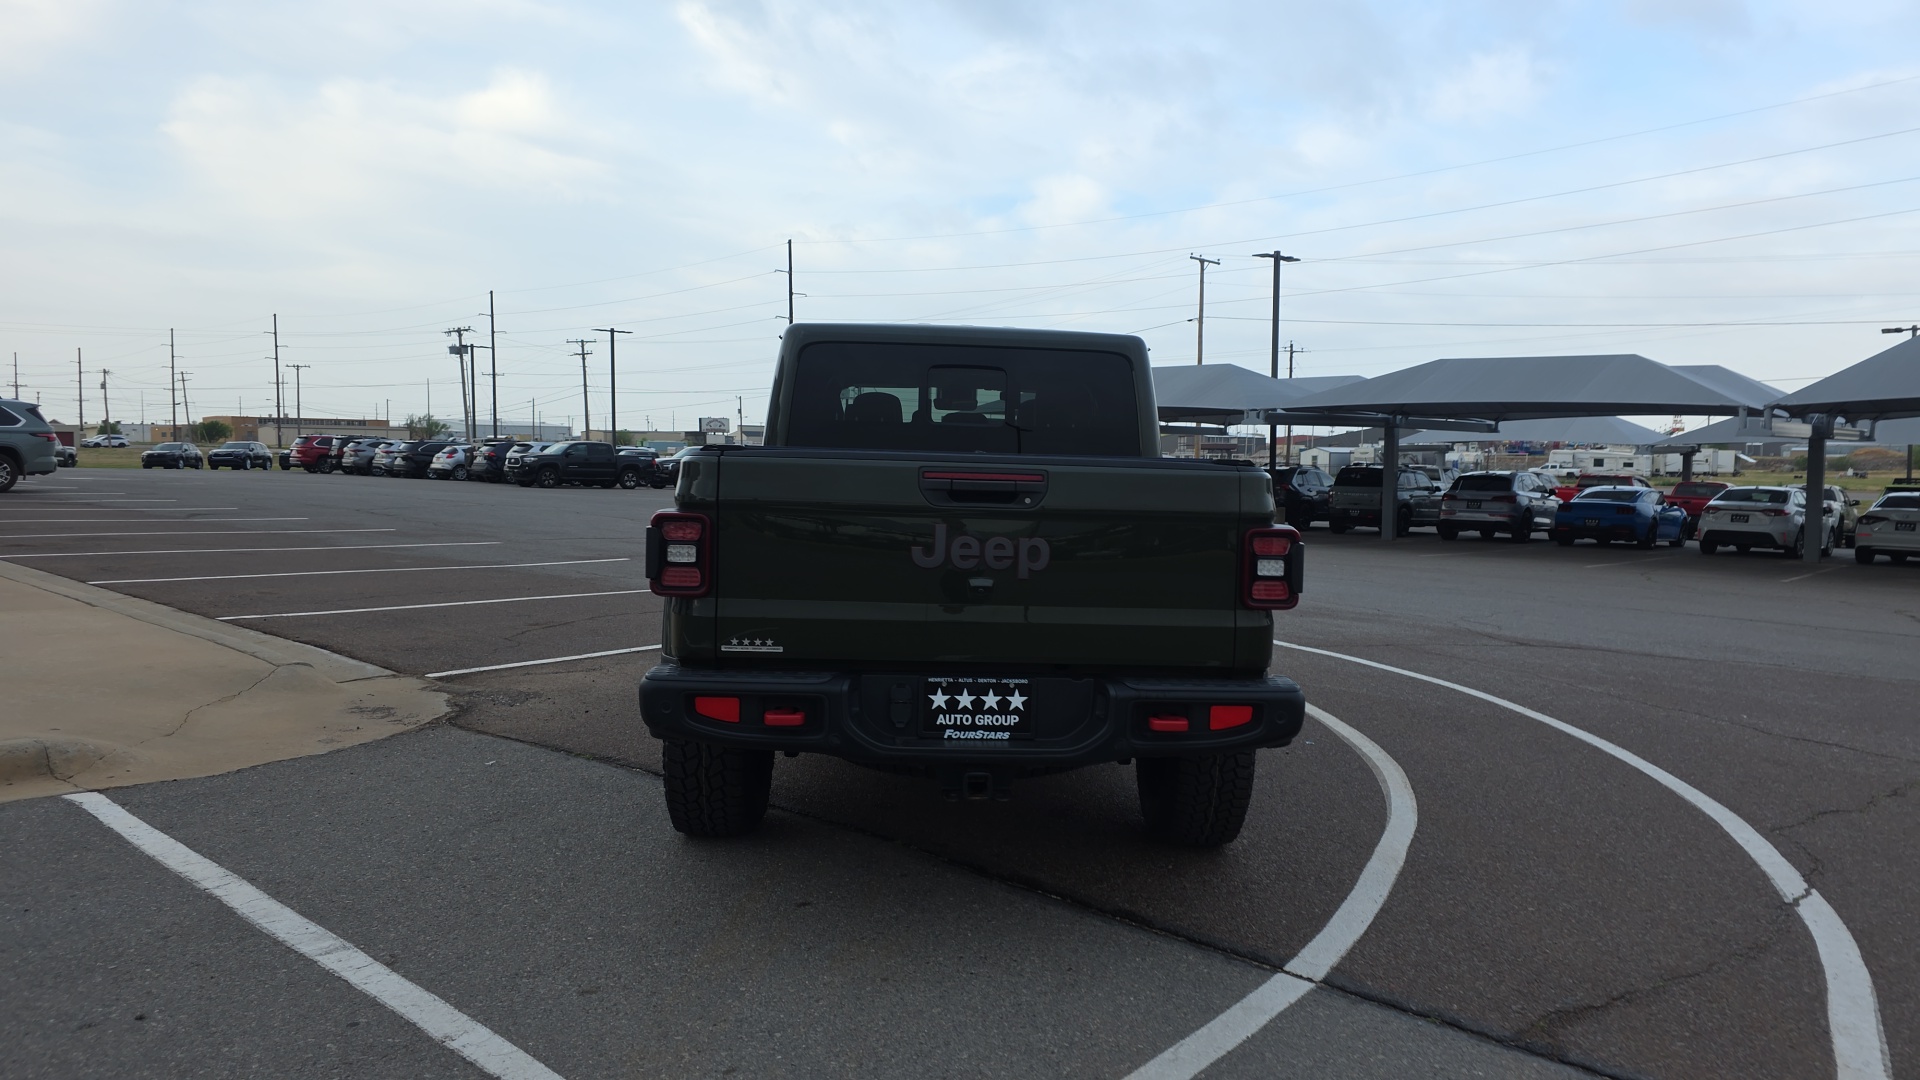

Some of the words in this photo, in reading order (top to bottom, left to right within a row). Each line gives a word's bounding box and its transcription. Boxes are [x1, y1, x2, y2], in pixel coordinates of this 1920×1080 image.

[911, 523, 1050, 579] Jeep
[936, 714, 972, 725] AUTO
[975, 714, 1019, 726] GROUP
